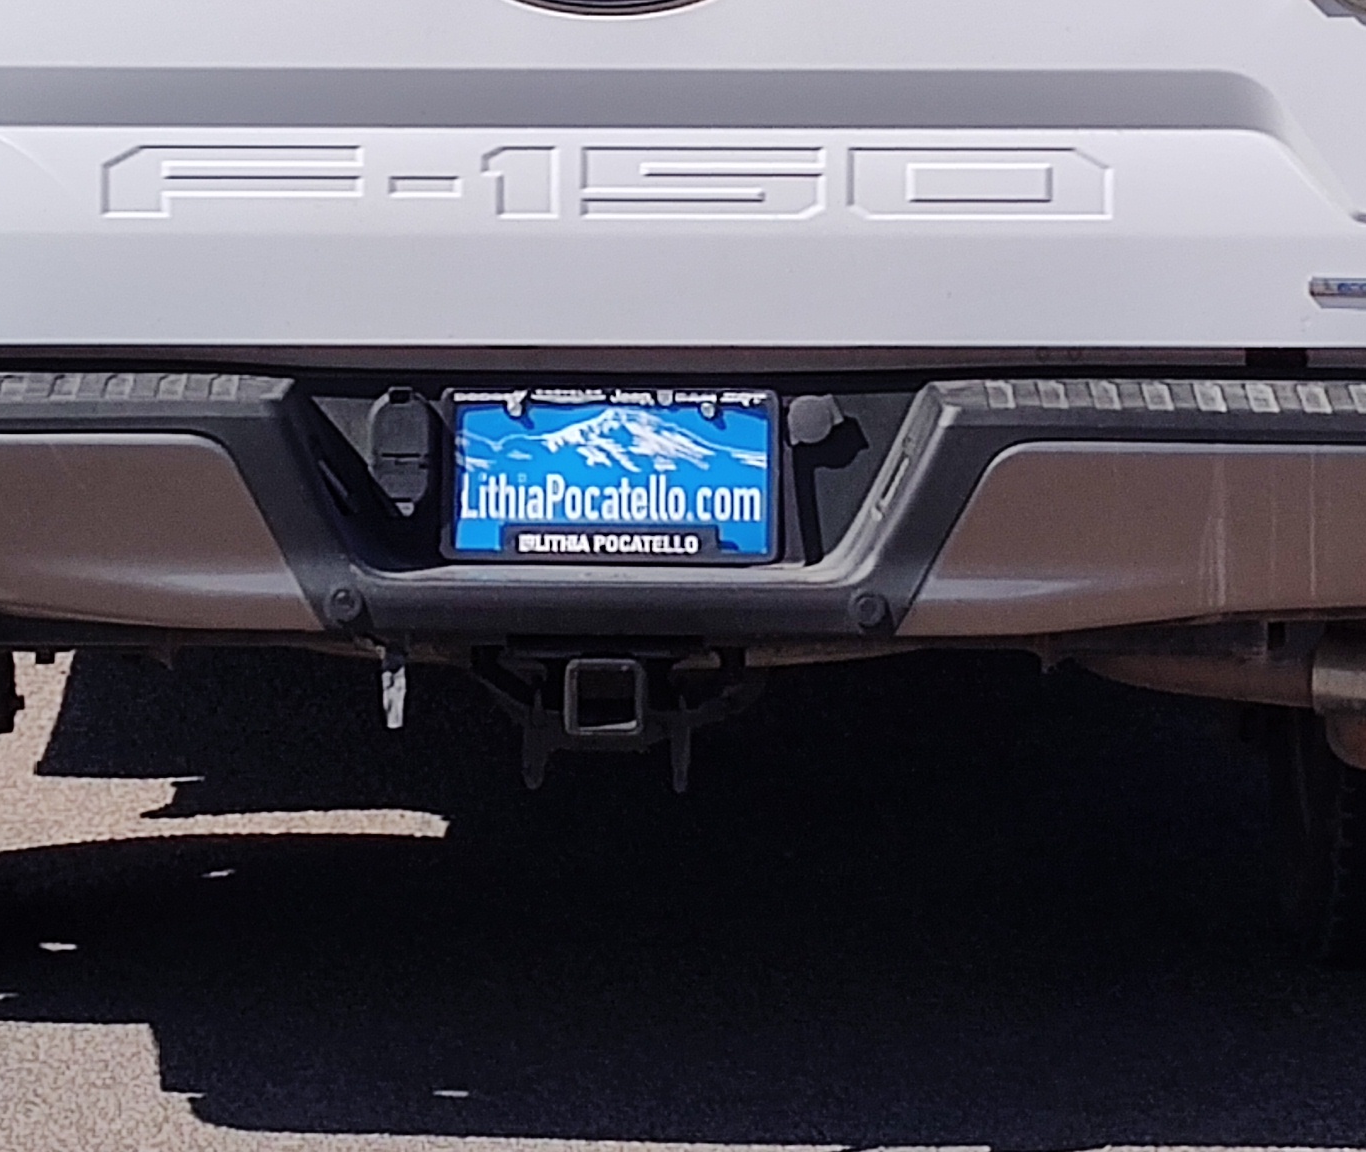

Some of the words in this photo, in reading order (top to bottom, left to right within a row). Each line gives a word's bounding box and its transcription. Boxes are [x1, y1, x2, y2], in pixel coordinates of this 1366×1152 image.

[101, 145, 1113, 220] F-150
[460, 474, 762, 522] LithiaPocatello.com
[535, 534, 591, 553] LITHIA
[594, 535, 700, 554] POCATELLO
